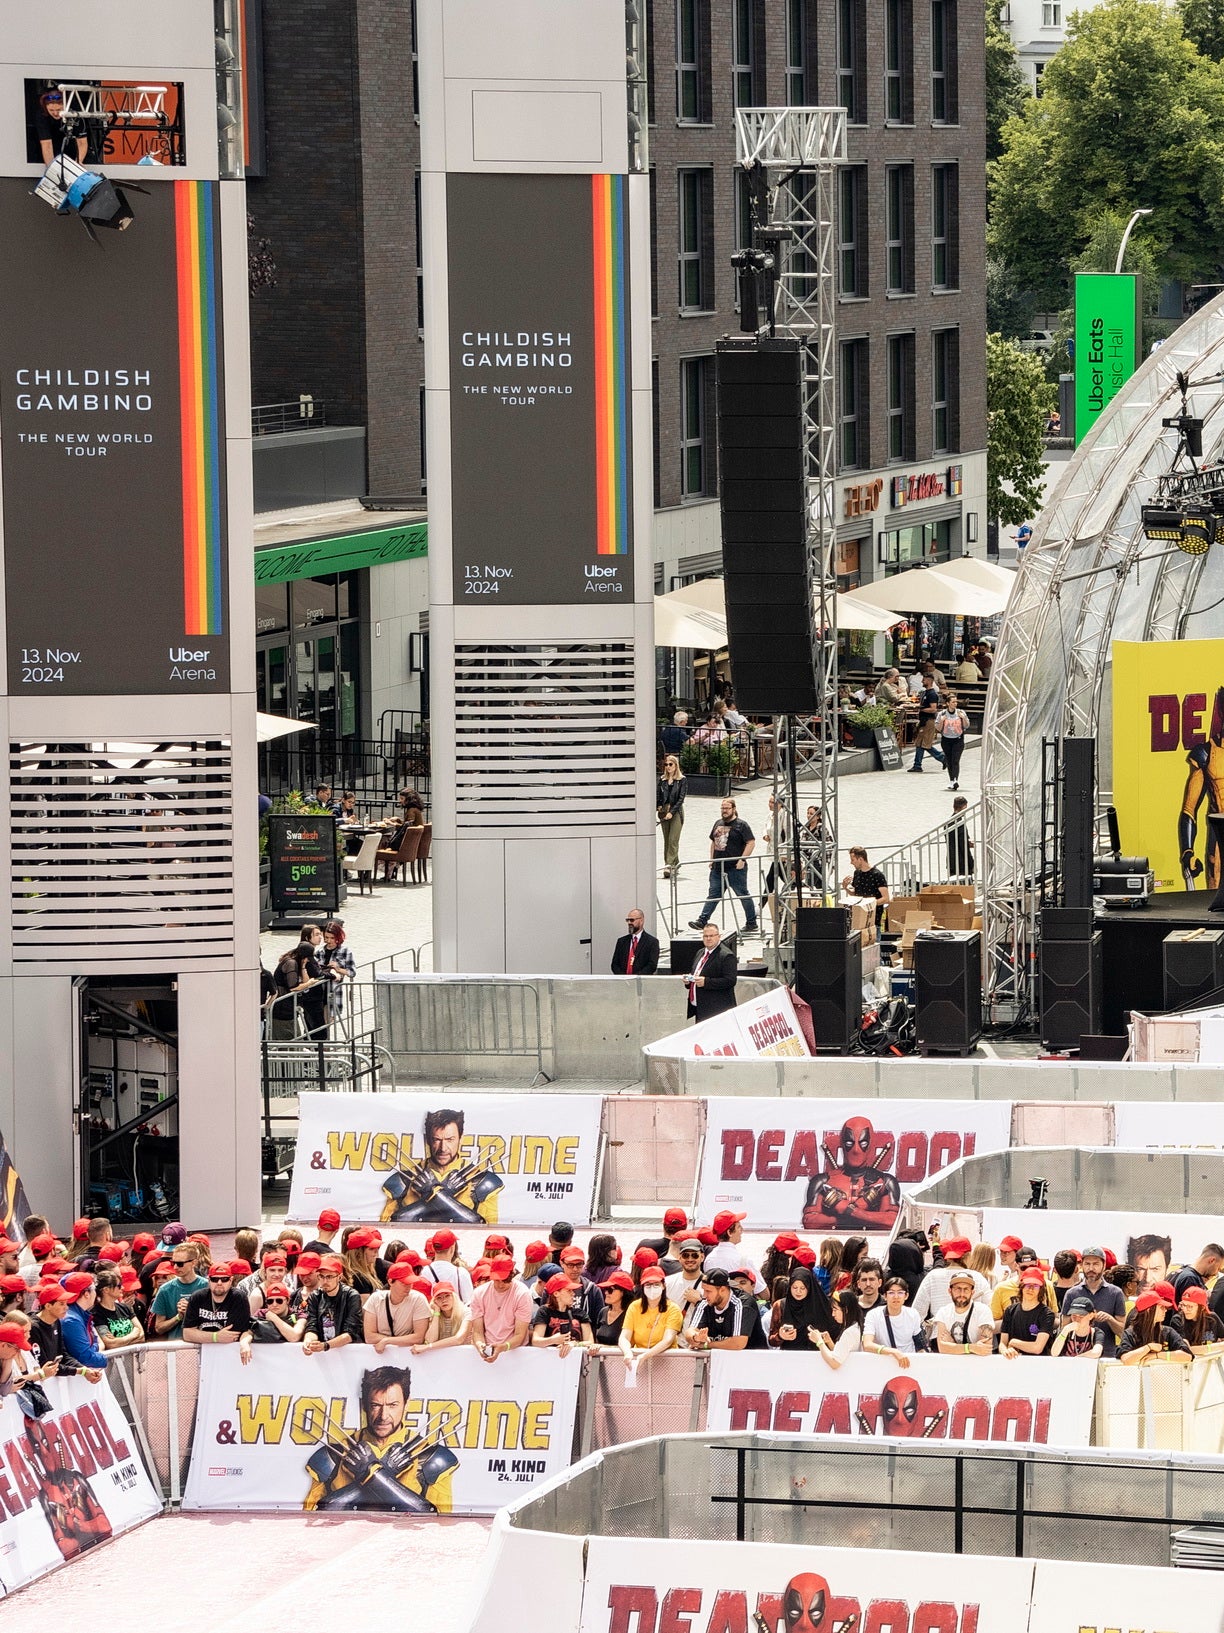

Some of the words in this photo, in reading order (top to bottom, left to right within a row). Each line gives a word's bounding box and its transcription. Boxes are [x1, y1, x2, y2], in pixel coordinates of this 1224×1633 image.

[463, 332, 571, 346] CHILDISH
[1088, 317, 1104, 363] Eats
[1108, 328, 1124, 358] Hall
[462, 353, 573, 367] GAMBINO
[16, 369, 151, 386] CHILDISH
[1108, 362, 1124, 400] sic
[463, 385, 488, 394] THE
[493, 385, 522, 394] NEW
[527, 385, 573, 394] WORLD
[1088, 368, 1104, 412] Uber
[16, 394, 152, 411] GAMBINO
[500, 396, 536, 405] TOUR
[17, 433, 49, 443] THE
[55, 433, 90, 443] NEW
[97, 433, 153, 443] WORLD
[64, 446, 108, 456] TOUR
[464, 565, 482, 579] 13.
[485, 565, 514, 579] Nov.
[584, 564, 618, 578] Uber
[464, 581, 500, 594] 2024
[584, 580, 623, 593] Arena
[306, 607, 325, 620] Eingang
[256, 616, 276, 629] Eingang
[21, 648, 43, 664] 13.
[46, 648, 82, 664] Nov.
[169, 647, 210, 662] Uber
[21, 667, 65, 682] 2024
[169, 666, 217, 680] Arena
[286, 829, 319, 840] Swadesh
[748, 1011, 794, 1051] DEADPOOL
[326, 1131, 581, 1175] WOLERINE
[526, 1181, 542, 1193] IM
[545, 1182, 574, 1193] KINO
[534, 1192, 548, 1200] 24.
[235, 1394, 555, 1450] WOLERINE
[208, 1467, 226, 1477] MARVEL
[226, 1468, 244, 1477] STUDIOS
[487, 1458, 506, 1473] IM
[511, 1459, 547, 1474] KINO
[110, 1471, 122, 1486] IM
[121, 1463, 138, 1481] KINO
[497, 1473, 513, 1482] 24.
[515, 1474, 535, 1482] JULI
